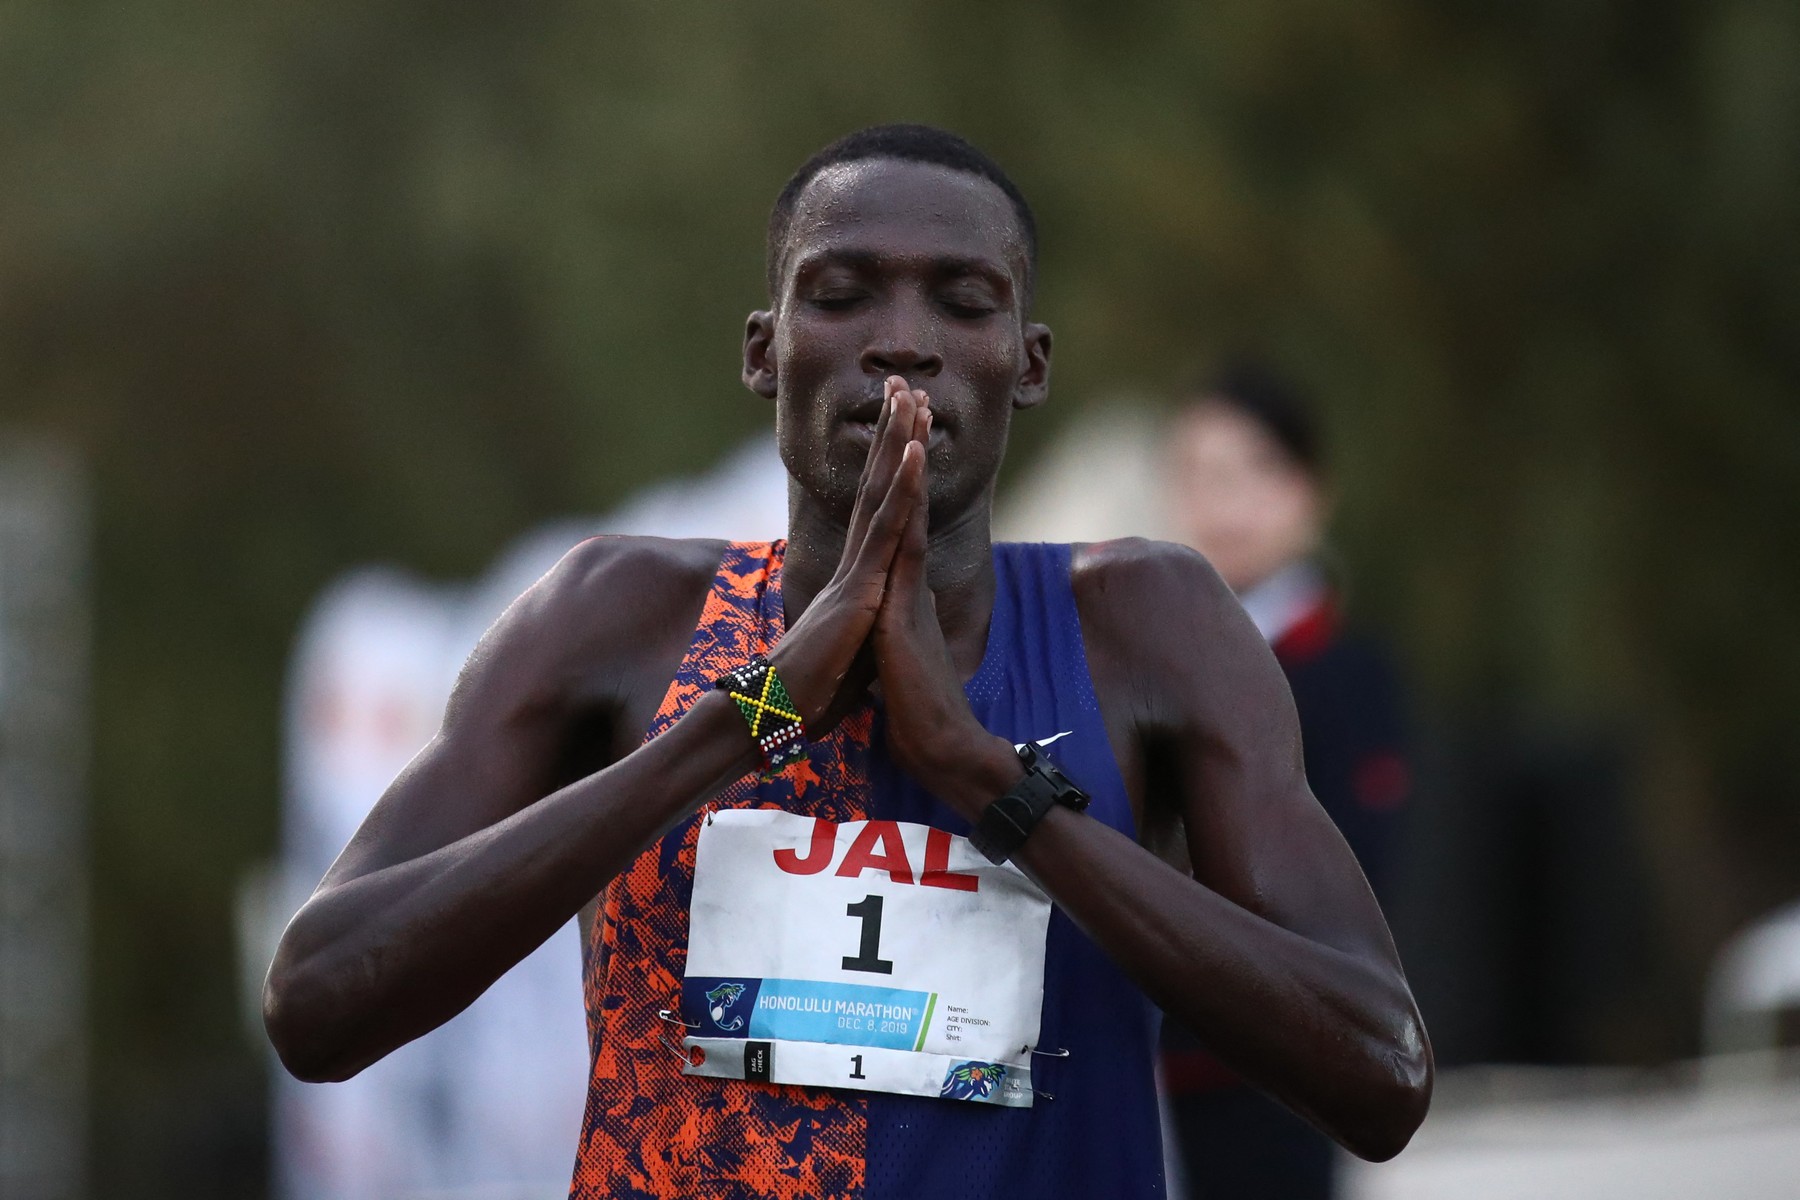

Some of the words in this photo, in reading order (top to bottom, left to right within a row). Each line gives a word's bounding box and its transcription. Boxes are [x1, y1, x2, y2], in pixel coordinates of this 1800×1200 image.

[773, 817, 979, 892] JAL
[842, 894, 893, 975] 1
[759, 995, 832, 1013] HONOLULU
[947, 1005, 969, 1014] Name:
[837, 1017, 863, 1030] DEC.
[880, 1021, 907, 1034] 2019
[946, 1024, 962, 1032] CITY:
[960, 1017, 991, 1026] DIVISION:
[946, 1033, 962, 1041] Shirt:
[849, 1054, 866, 1080] 1
